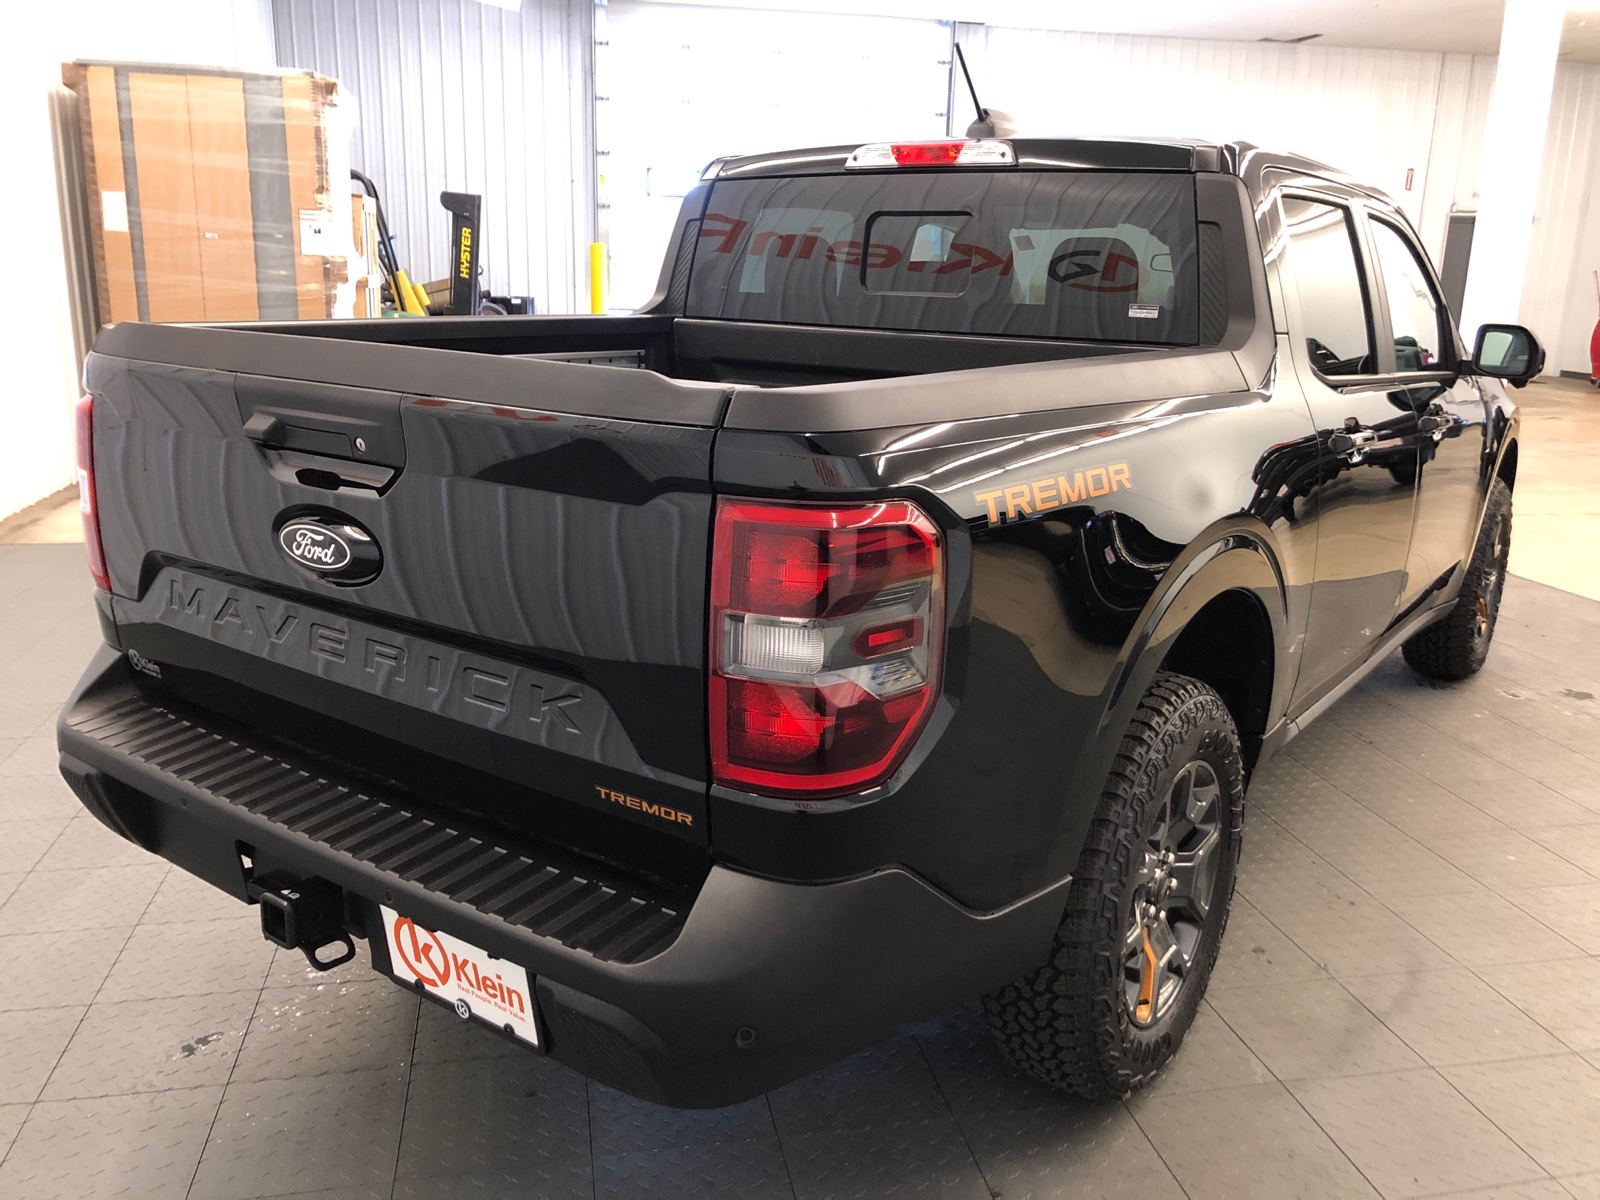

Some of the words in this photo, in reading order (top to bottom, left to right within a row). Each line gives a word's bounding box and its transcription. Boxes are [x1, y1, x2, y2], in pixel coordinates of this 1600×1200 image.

[460, 227, 472, 279] HYSTER
[974, 461, 1134, 525] TREMOR
[292, 529, 336, 564] Ford
[168, 578, 583, 735] MAVERICK
[595, 785, 693, 826] TREMOR
[451, 951, 526, 1015] Klein
[457, 983, 470, 995] Real
[494, 1001, 507, 1013] Real
